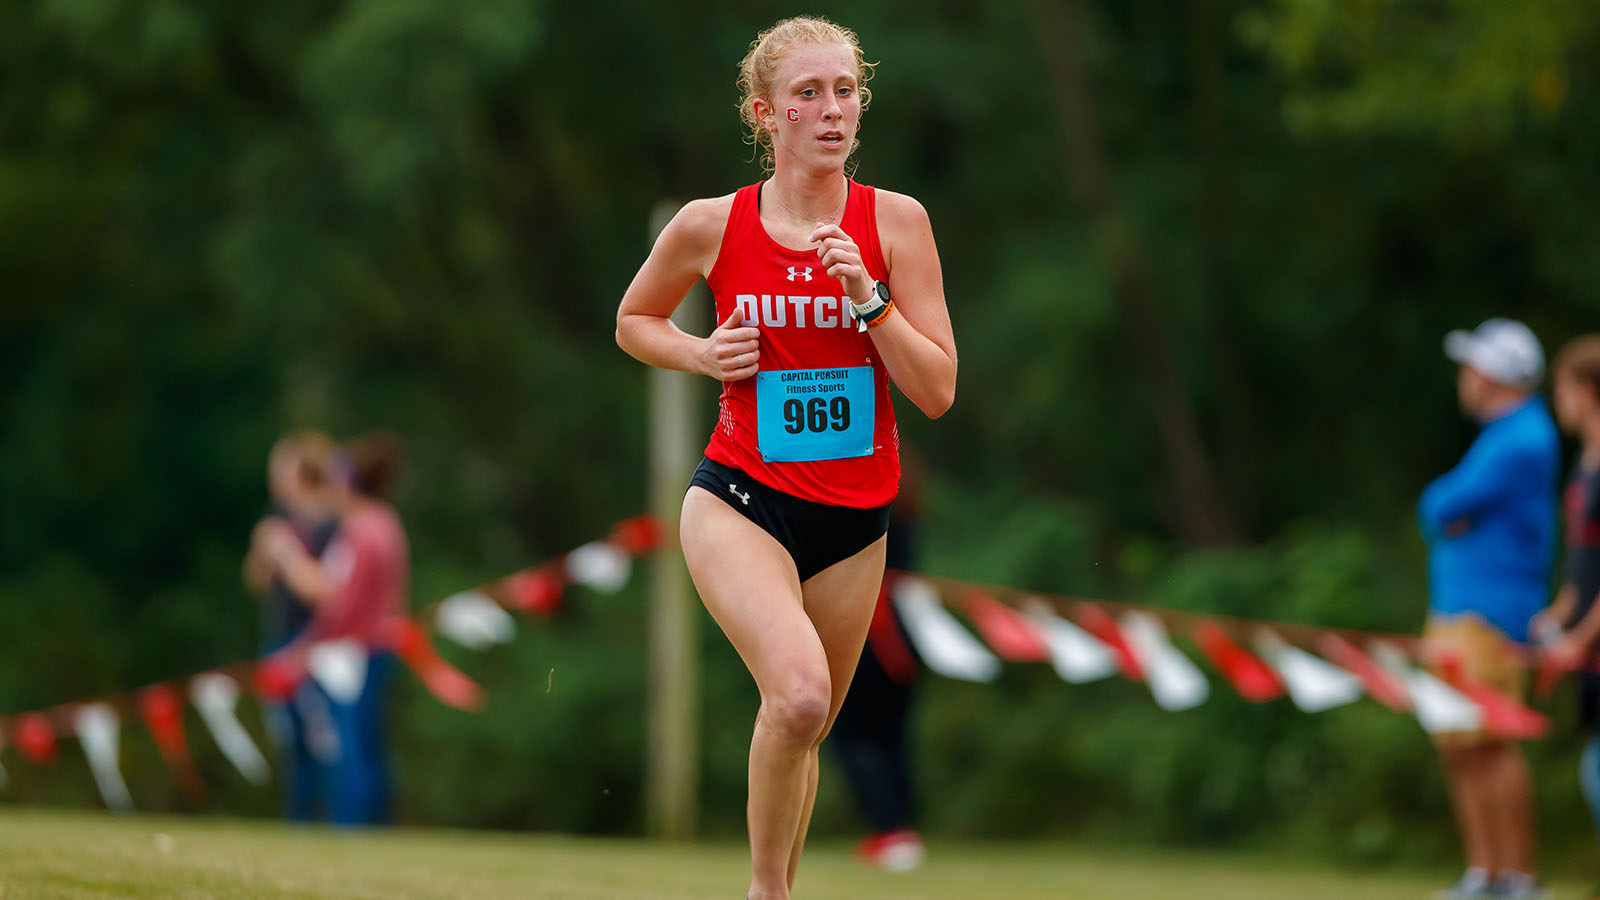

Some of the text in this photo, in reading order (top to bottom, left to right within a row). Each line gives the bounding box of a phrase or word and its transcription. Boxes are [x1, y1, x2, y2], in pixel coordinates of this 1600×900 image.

[786, 106, 800, 124] C
[781, 369, 849, 382] CAPITAL PURSUIT
[786, 383, 846, 394] Fitness Sports
[783, 396, 850, 434] 969
